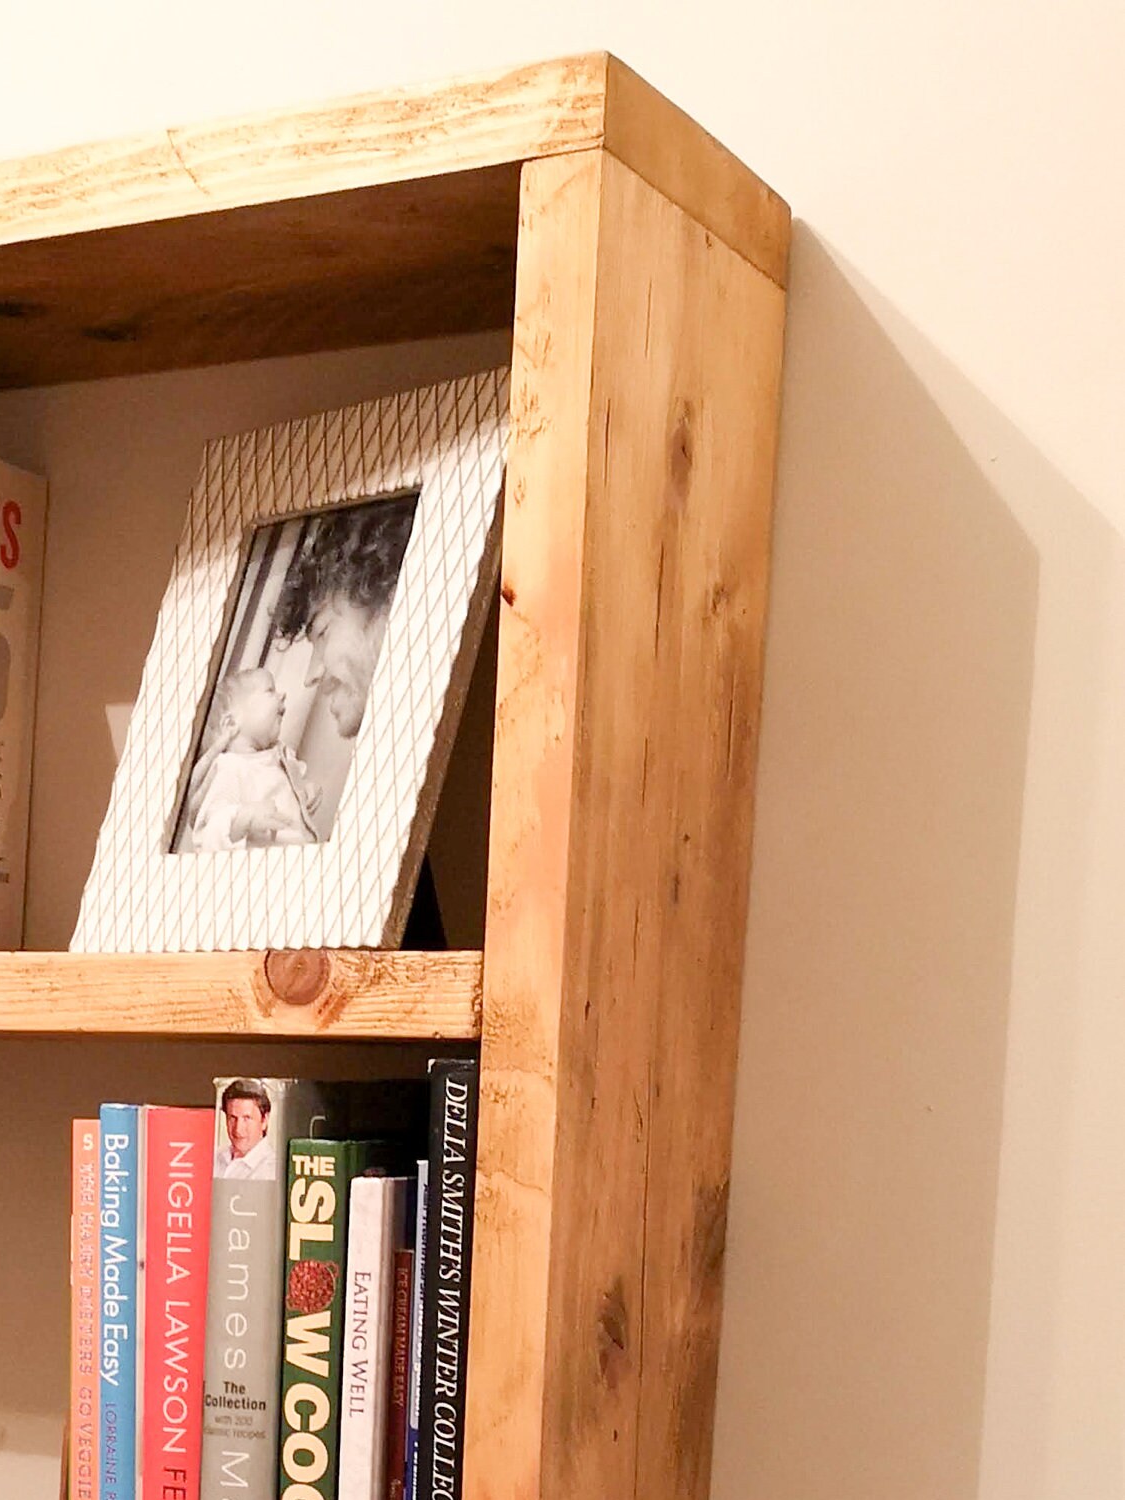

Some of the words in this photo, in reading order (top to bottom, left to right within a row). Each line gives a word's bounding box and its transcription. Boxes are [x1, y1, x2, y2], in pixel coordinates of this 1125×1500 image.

[441, 1079, 468, 1164] DELIA
[79, 1163, 94, 1207] THE
[100, 1134, 129, 1228] Baking
[292, 1155, 336, 1177] THE
[79, 1212, 93, 1280] HAIRY
[165, 1142, 195, 1285] NIGELLA
[438, 1169, 465, 1281] SMITH'S
[103, 1235, 129, 1318] Made
[224, 1195, 257, 1369] James
[352, 1271, 371, 1351] EATING
[396, 1268, 409, 1288] ICE
[396, 1291, 408, 1333] CREAM
[78, 1286, 93, 1376] DIETERS
[101, 1324, 128, 1387] Easy
[395, 1335, 405, 1374] MADE
[434, 1287, 461, 1397] WINTER
[78, 1387, 92, 1416] GO
[162, 1300, 190, 1453] LAWSON
[205, 1394, 266, 1411] Collection
[223, 1381, 246, 1394] The
[349, 1360, 369, 1418] WELL
[394, 1376, 405, 1406] EASY
[78, 1423, 92, 1499] VEGGIE
[105, 1403, 117, 1484] LORRAINE
